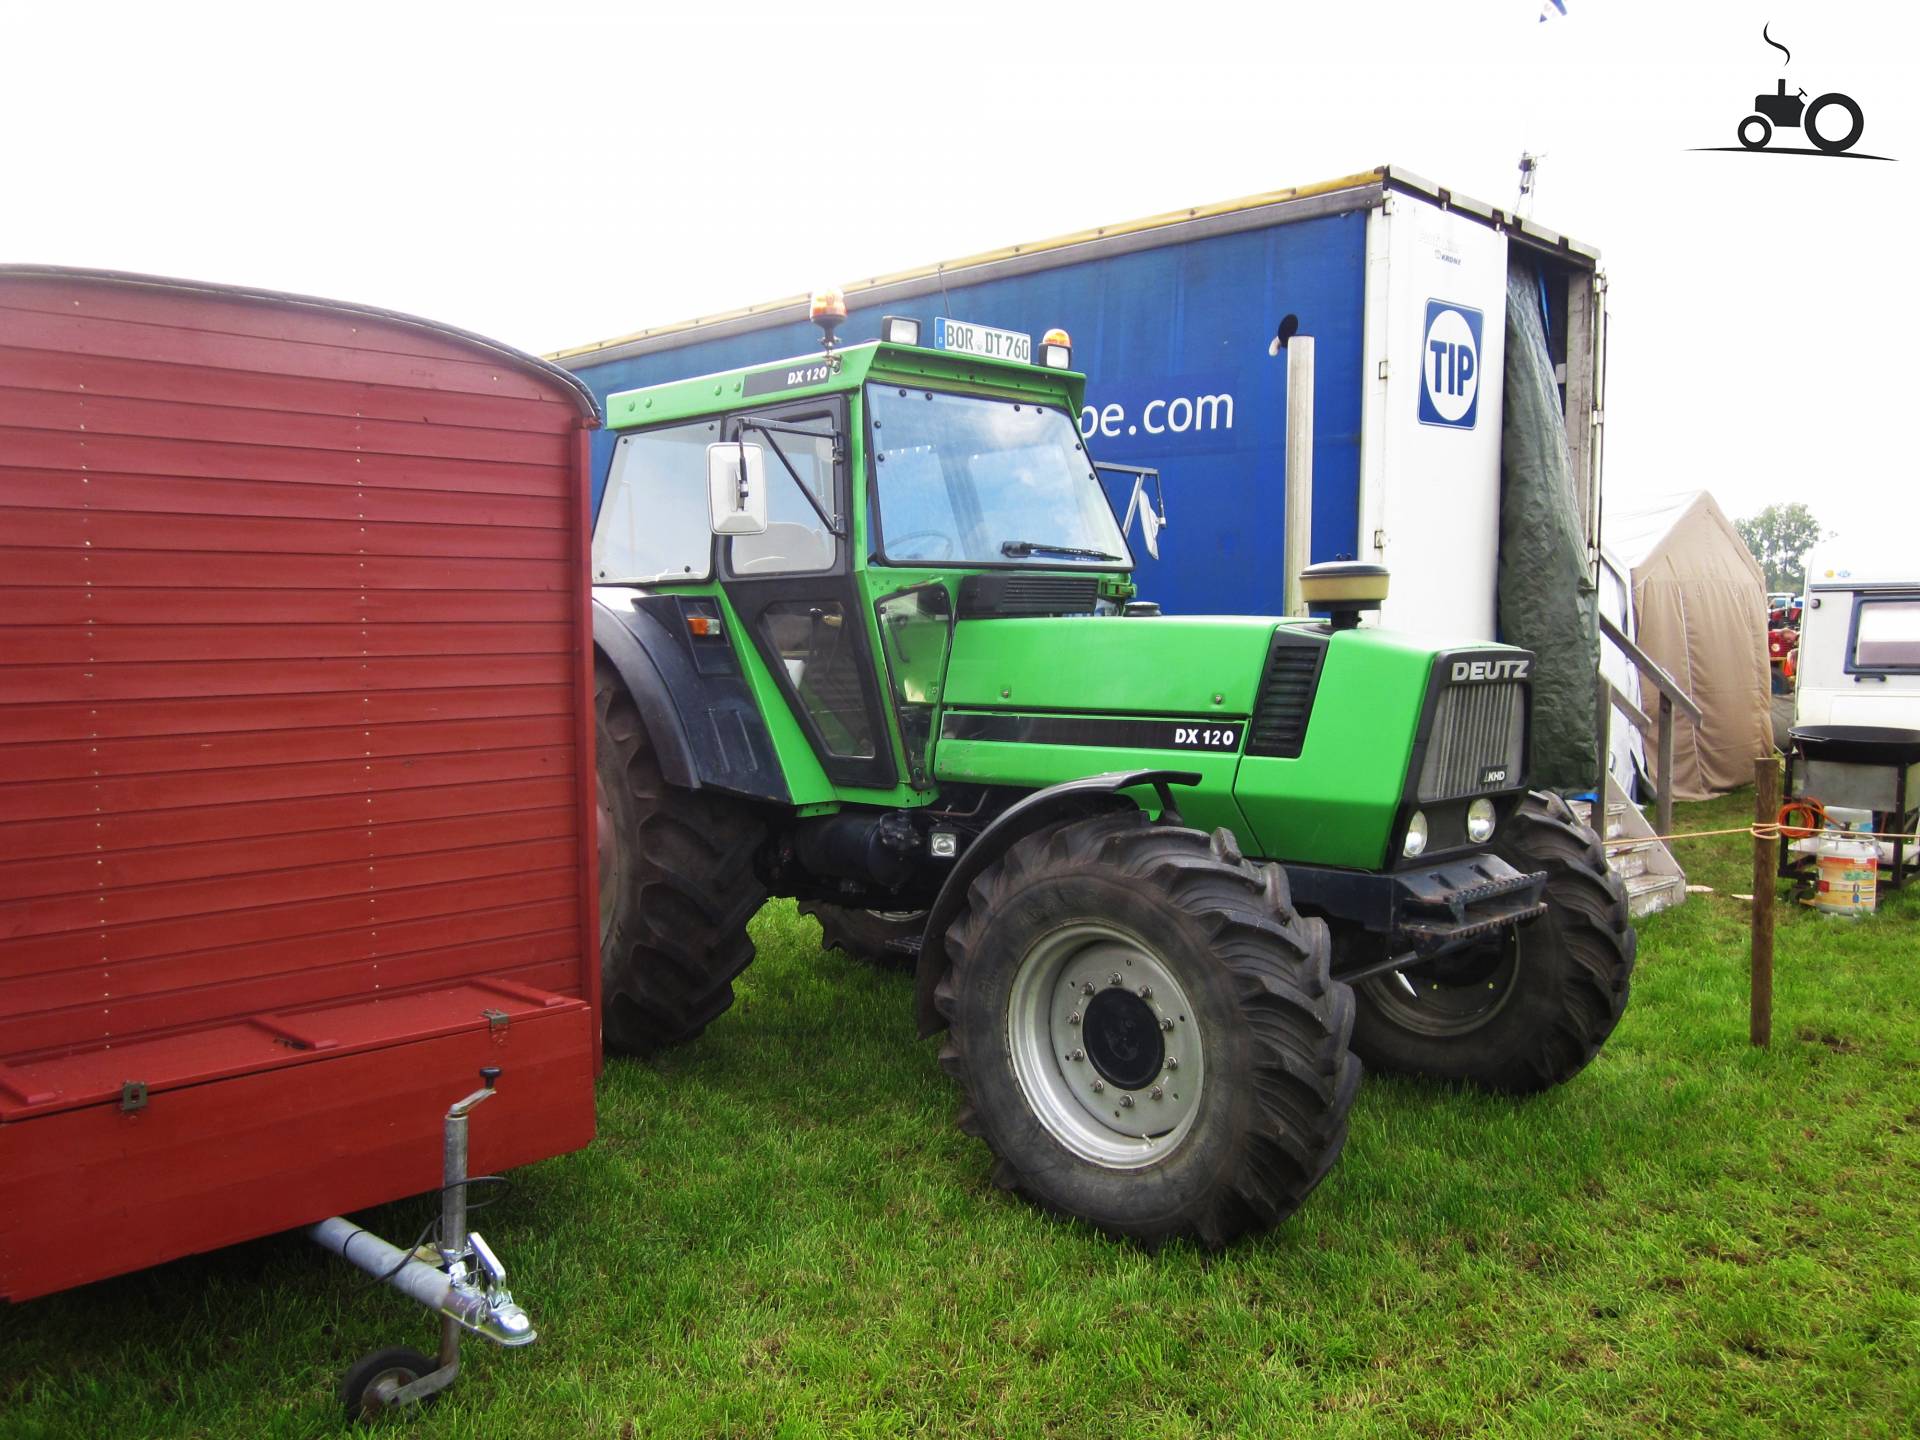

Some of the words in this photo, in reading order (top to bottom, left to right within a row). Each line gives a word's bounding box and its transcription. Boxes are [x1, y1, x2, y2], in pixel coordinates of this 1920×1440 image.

[946, 325, 974, 351] BOR
[985, 331, 1003, 355] DT
[1005, 336, 1029, 361] 760
[787, 370, 803, 384] DX
[807, 366, 827, 381] 120
[1430, 339, 1475, 397] TIP
[1451, 660, 1530, 681] DEUTZ
[1174, 728, 1199, 744] DX
[1203, 729, 1234, 746] 120
[1487, 770, 1506, 782] KHD
